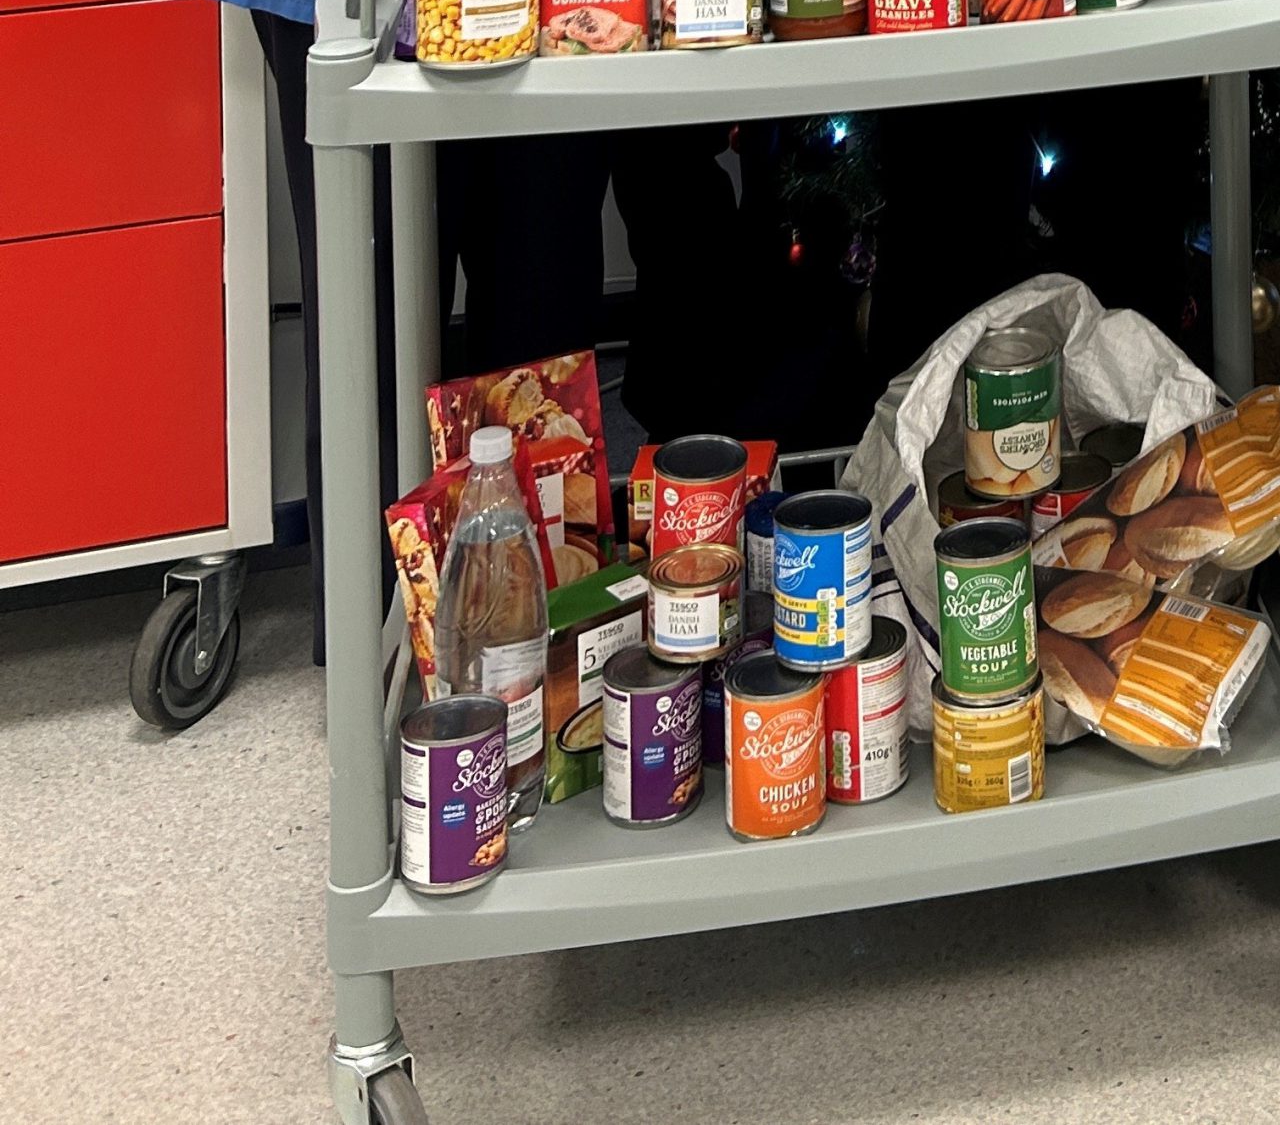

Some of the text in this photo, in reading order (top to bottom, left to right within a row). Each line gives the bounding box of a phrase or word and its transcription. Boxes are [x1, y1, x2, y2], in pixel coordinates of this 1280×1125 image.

[695, 6, 728, 19] HAM
[874, 9, 935, 21] GRANULES
[993, 396, 1032, 407] POTATOES
[659, 483, 742, 531] Stockwell
[943, 565, 1027, 618] Stockwell
[669, 601, 699, 612] TESCO
[668, 615, 700, 624] DANISH
[669, 623, 699, 635] HAM
[582, 646, 597, 670] 5
[960, 638, 1018, 661] VEGETABLE
[970, 659, 1009, 674] SOUP
[740, 703, 824, 761] Stockwell
[759, 774, 817, 804] CHICKEN
[771, 795, 808, 815] SOUP
